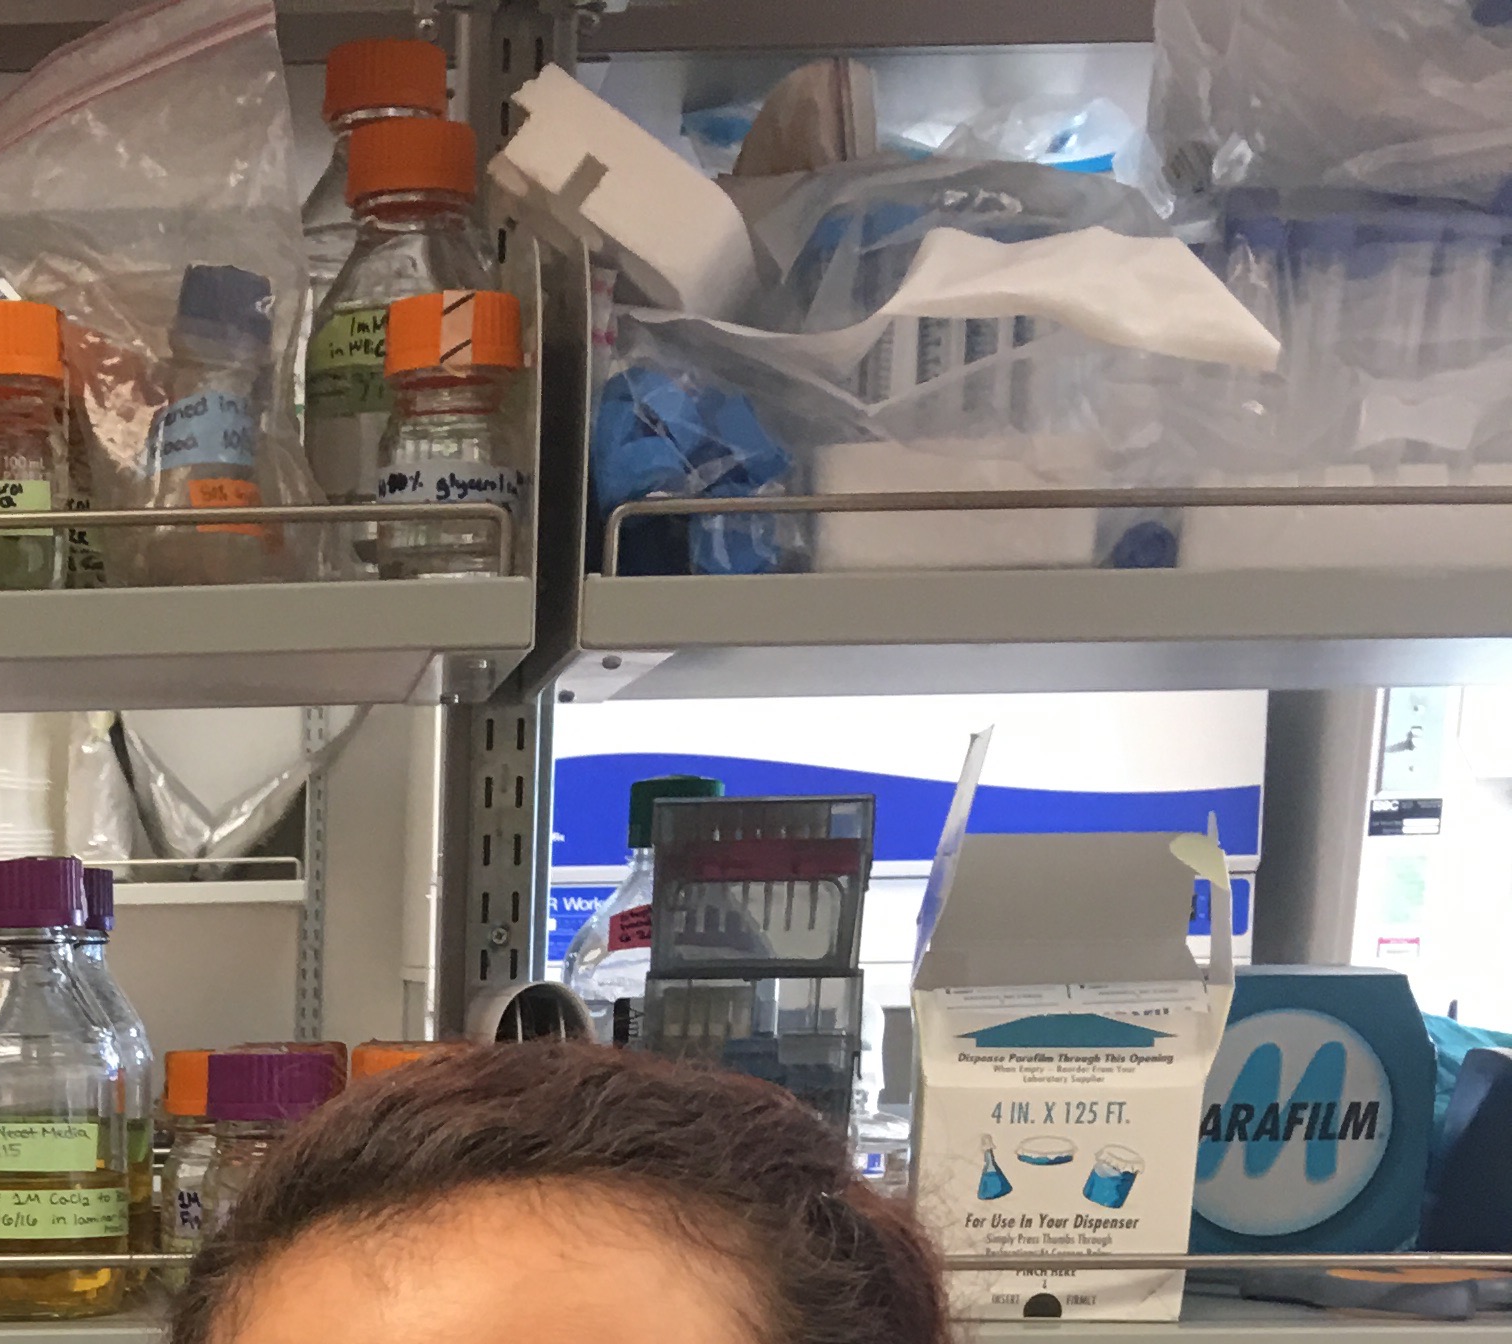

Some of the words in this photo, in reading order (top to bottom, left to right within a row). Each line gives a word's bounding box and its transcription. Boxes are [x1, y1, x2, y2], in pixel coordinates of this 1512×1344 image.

[957, 1052, 1006, 1065] Dispense
[1008, 1052, 1055, 1065] Parafilm
[1058, 1053, 1101, 1066] Through
[1104, 1052, 1126, 1064] This
[1129, 1053, 1174, 1066] Opening
[990, 1100, 1003, 1124] 4
[1009, 1100, 1036, 1124] IN.
[1043, 1100, 1056, 1124] X
[1064, 1100, 1100, 1124] 125
[1104, 1100, 1131, 1124] FT.
[1198, 1100, 1380, 1143] ARAFILM
[41, 1125, 92, 1141] Media
[964, 1212, 988, 1230] For
[990, 1213, 1016, 1230] Use
[1019, 1213, 1033, 1229] In
[1037, 1213, 1069, 1230] Your
[1072, 1213, 1140, 1233] Dispenser
[985, 1233, 1016, 1247] Simply
[1042, 1233, 1075, 1245] Thumbs
[1077, 1233, 1113, 1247] Through
